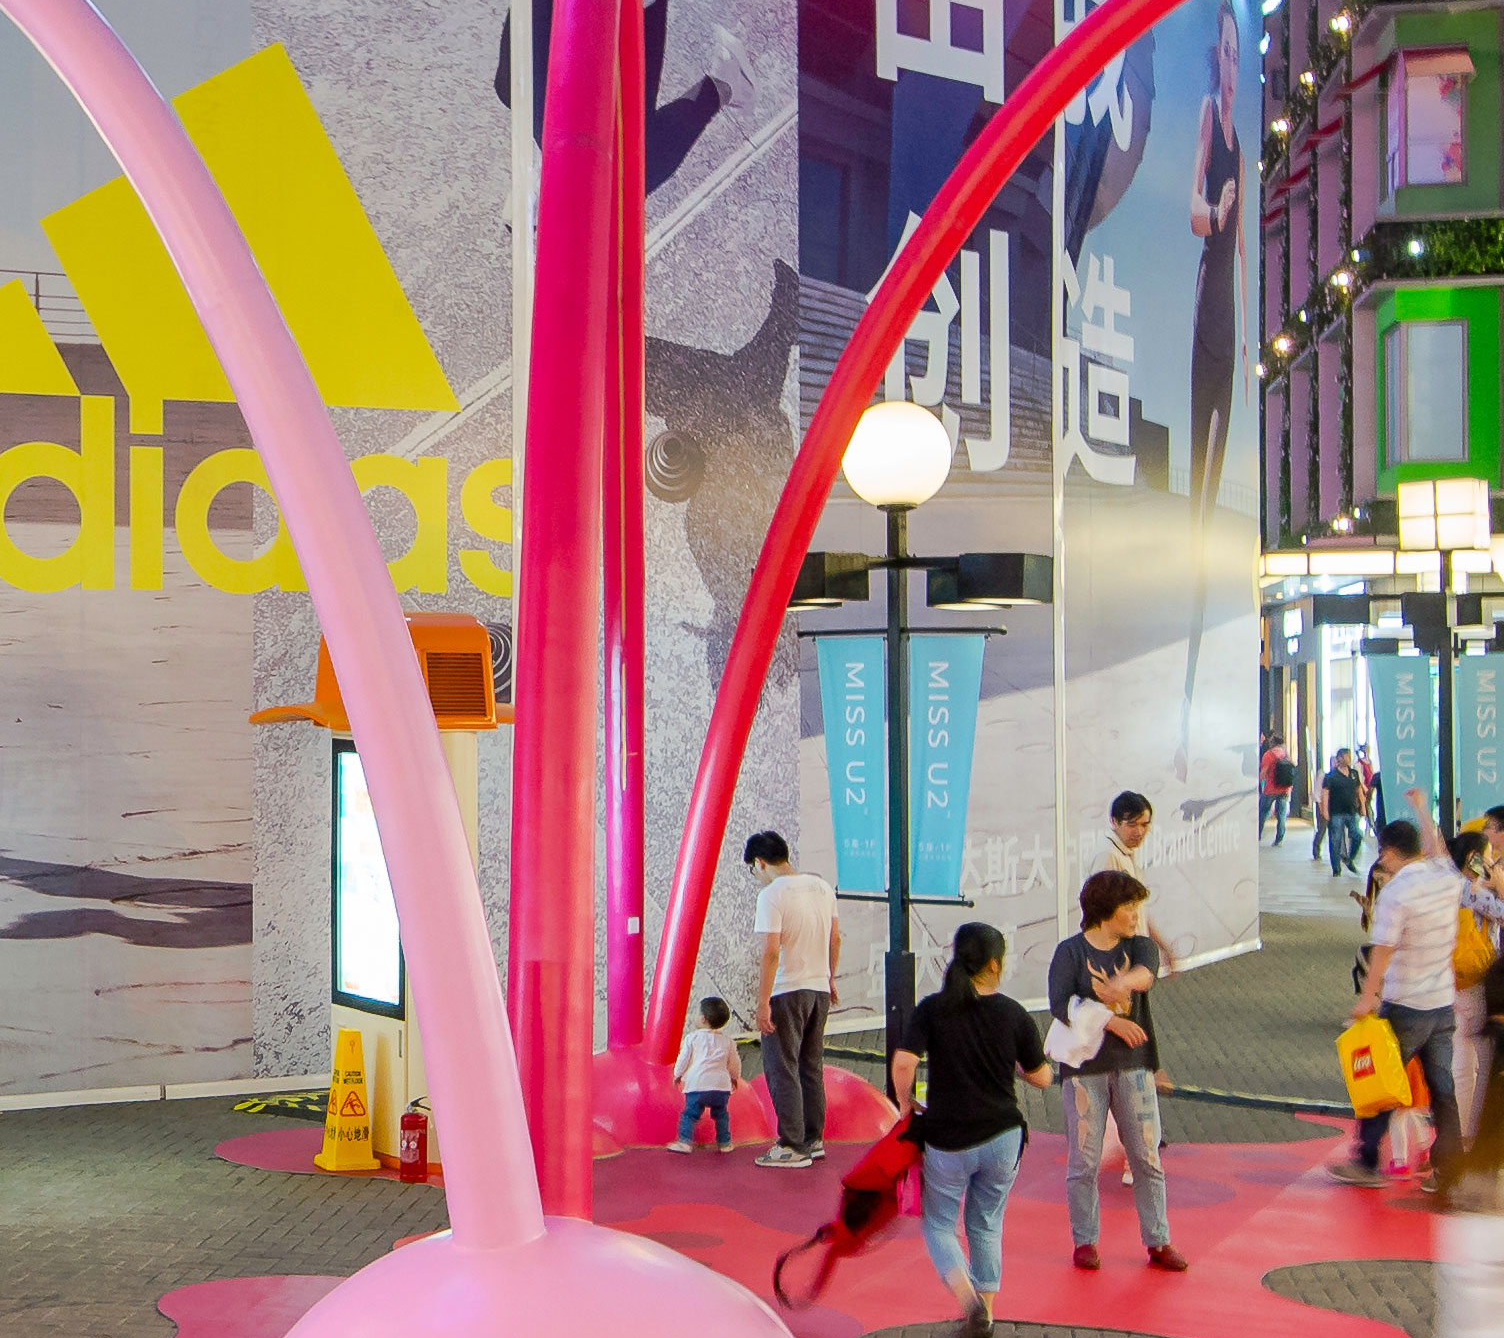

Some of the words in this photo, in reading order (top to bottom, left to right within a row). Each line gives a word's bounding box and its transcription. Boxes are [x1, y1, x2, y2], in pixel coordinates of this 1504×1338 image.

[844, 662, 866, 746] MISS
[927, 662, 950, 748] MISS
[1395, 671, 1415, 741] MISS
[1476, 669, 1497, 739] MISS
[844, 761, 867, 807] U2
[927, 763, 949, 809] U2
[1396, 748, 1416, 786] U2
[1476, 749, 1497, 786] U2
[338, 1125, 370, 1142] 小心地滑
